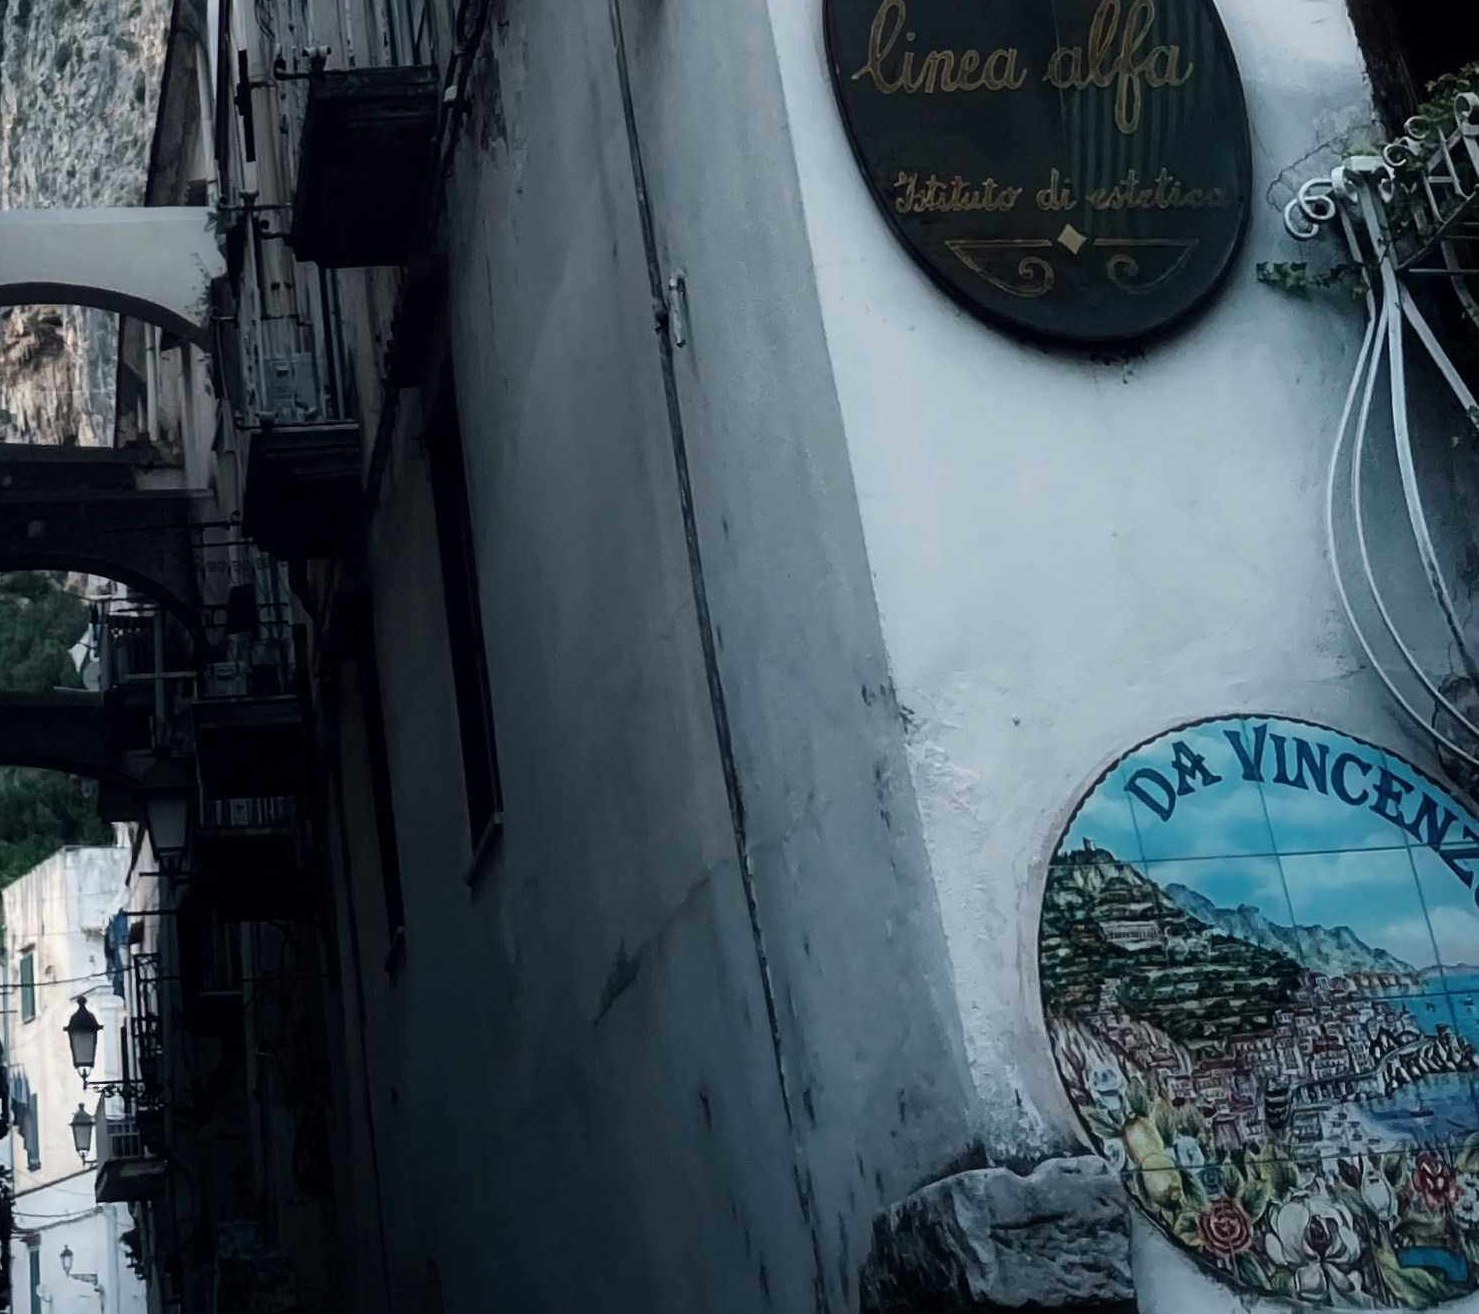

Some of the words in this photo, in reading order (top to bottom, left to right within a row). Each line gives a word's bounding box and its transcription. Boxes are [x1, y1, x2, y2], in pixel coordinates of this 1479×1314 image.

[893, 170, 1022, 214] Istituto
[1036, 167, 1077, 211] di
[1084, 167, 1230, 210] estetica
[1124, 740, 1222, 822] DA
[1223, 723, 1479, 906] VINCENZ
